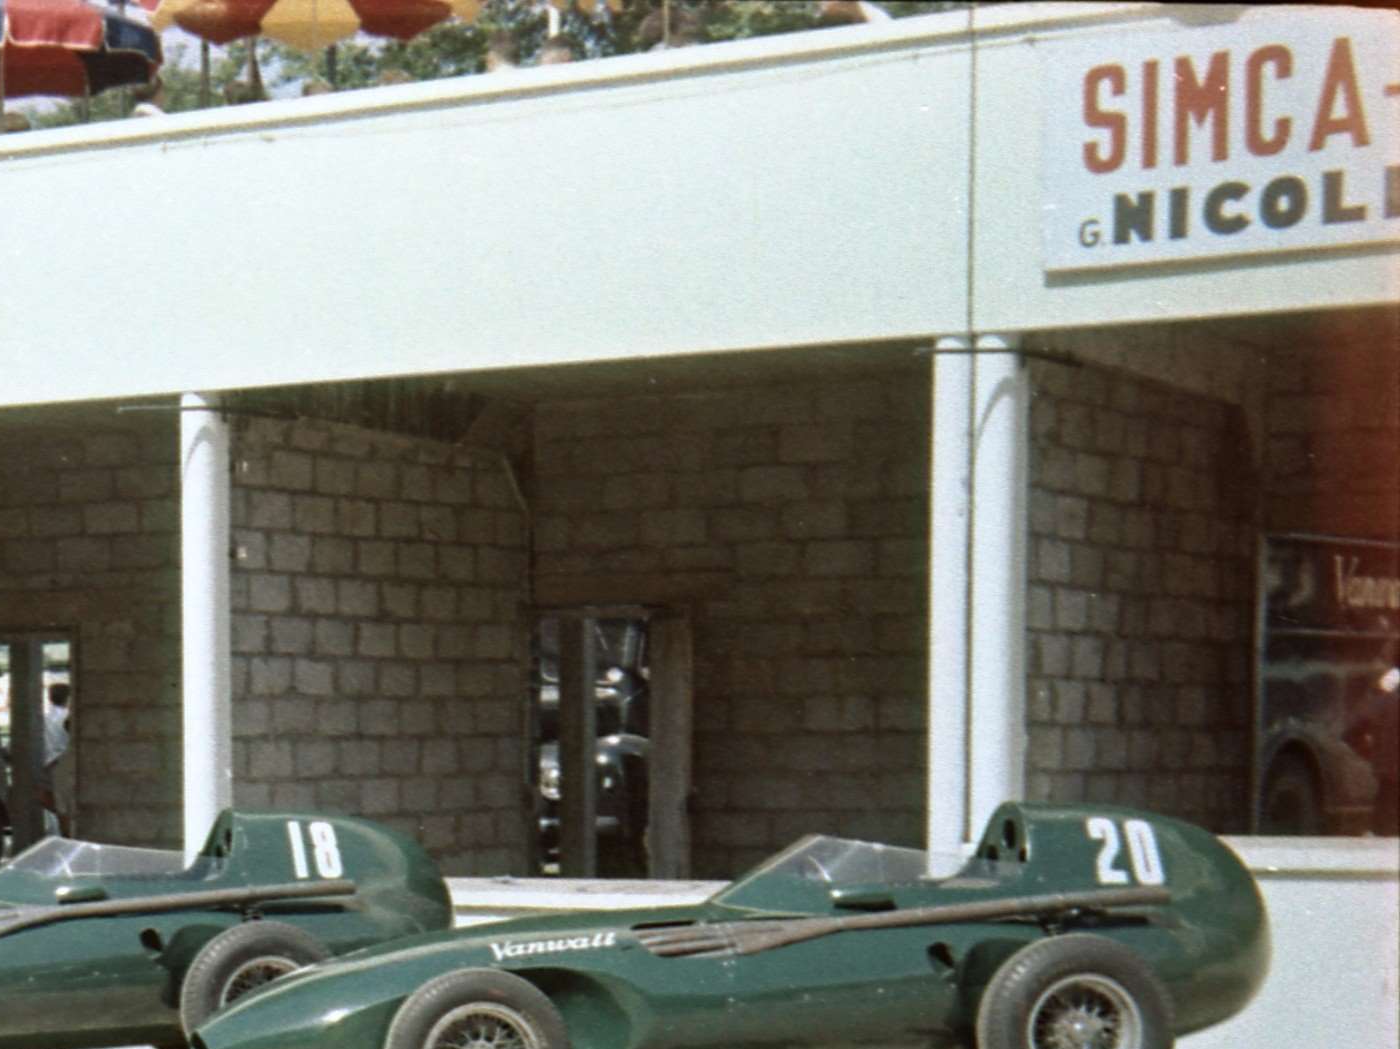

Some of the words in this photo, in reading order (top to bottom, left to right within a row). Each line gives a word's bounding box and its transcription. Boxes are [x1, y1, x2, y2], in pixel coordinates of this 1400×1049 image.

[287, 820, 343, 879] 18
[1085, 816, 1165, 885] 20
[490, 931, 617, 961] Vanwall
